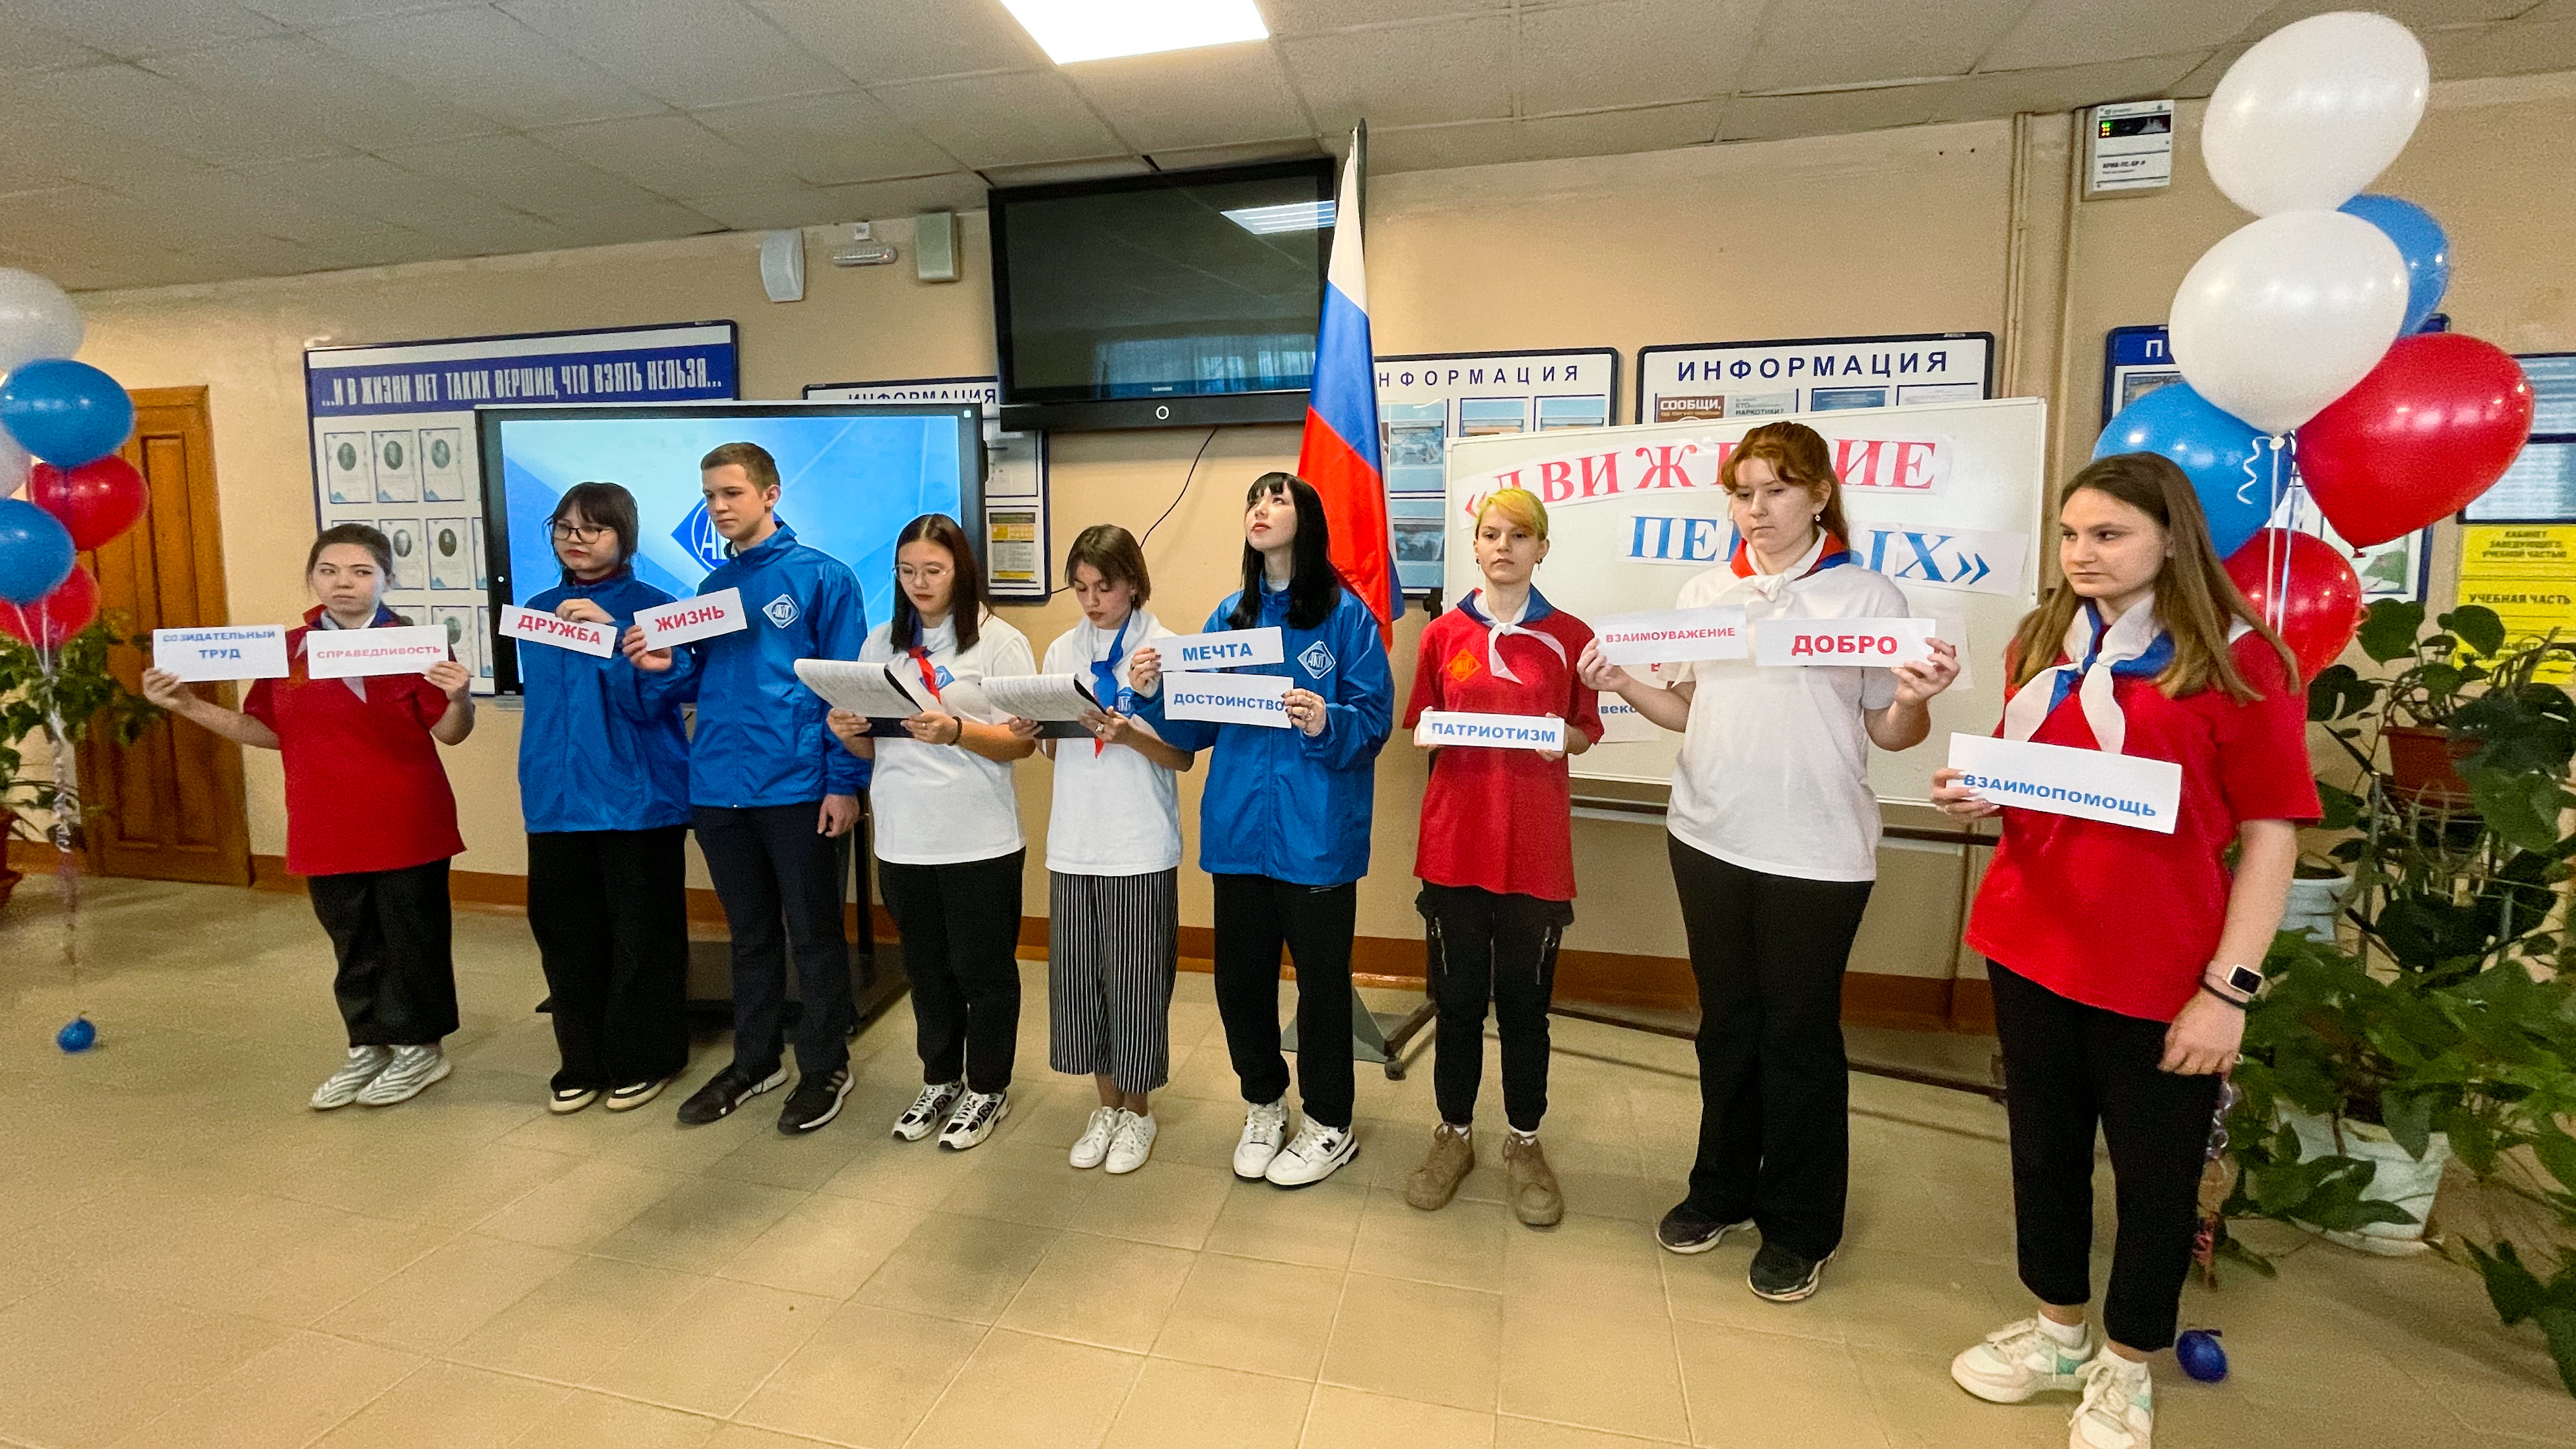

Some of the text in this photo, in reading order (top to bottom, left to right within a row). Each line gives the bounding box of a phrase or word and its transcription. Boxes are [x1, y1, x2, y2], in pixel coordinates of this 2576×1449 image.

[1379, 365, 1578, 387] НФОРМАЦИЯ
[1678, 351, 1946, 381] ИНФОРМАЦИЯ
[347, 377, 357, 405] В
[361, 374, 412, 405] ЖИЗНИ
[415, 373, 438, 401] НЕТ
[445, 370, 491, 401] ТАКИХ
[494, 366, 559, 399] ВЕРШИН,
[561, 365, 588, 394] ЧТО
[594, 362, 642, 394] ВЗЯТЬ
[2468, 594, 2571, 605] УЧЕБНАЯ ЧАСТЬ
[655, 605, 725, 633] ЖИЗНЬ
[518, 614, 602, 646] ДРУЖБА
[1606, 627, 1736, 644] ВЗАИМОУВАЖЕНИЕ
[199, 649, 241, 660] ТРУД
[317, 646, 441, 659] СПРАВЕДЛИВОСТЬ
[1182, 643, 1253, 661] МЕЧТА
[1791, 635, 1898, 657] ДОБРО
[1173, 693, 1284, 711] ДОСТОИНСТВО
[1432, 723, 1555, 743] ПАТРИОТИЗМ
[1964, 774, 2156, 816] ВЗАИМОПОМОЩЬ
